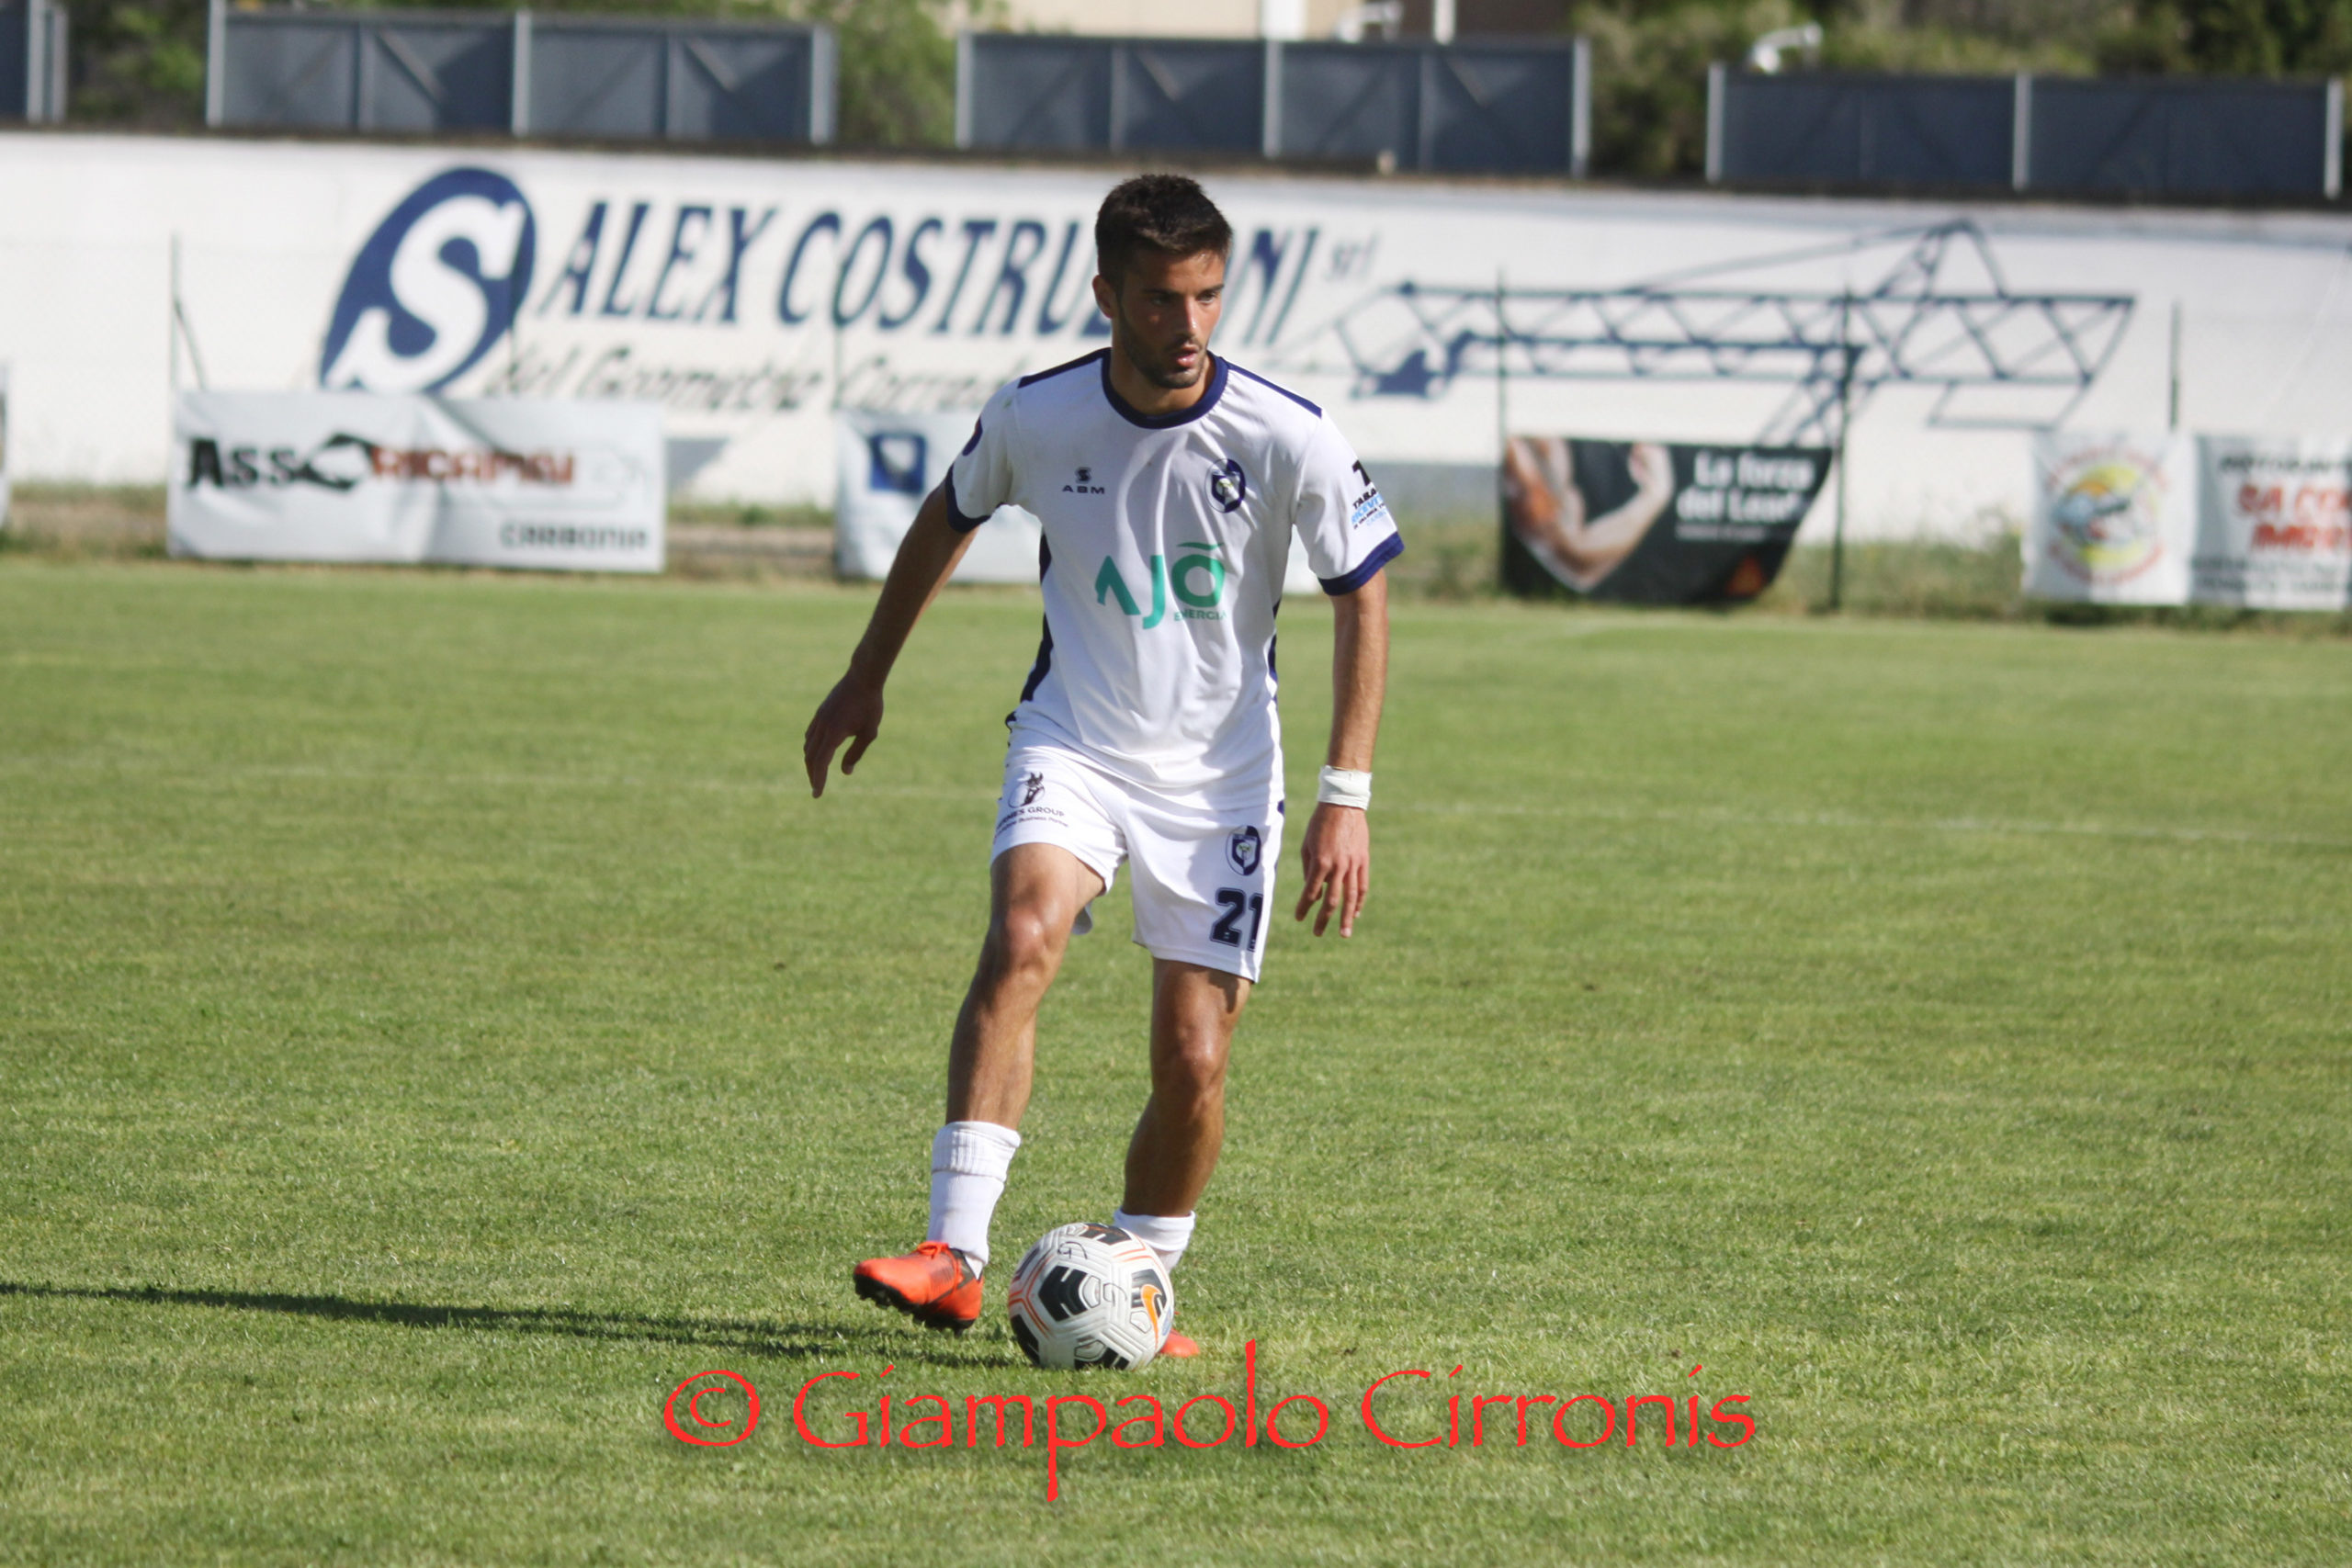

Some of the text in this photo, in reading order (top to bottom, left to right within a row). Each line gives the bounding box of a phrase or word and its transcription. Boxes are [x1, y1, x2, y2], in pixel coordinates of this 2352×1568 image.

[537, 200, 779, 325] ALEX
[777, 209, 1320, 347] COSTRUNI
[1694, 448, 1815, 491] La forza
[1061, 483, 1106, 495] ABM
[1352, 487, 1377, 510] TABA
[1173, 608, 1227, 622] ENERGIA
[1027, 807, 1065, 817] GROUP
[1209, 887, 1263, 953] 21
